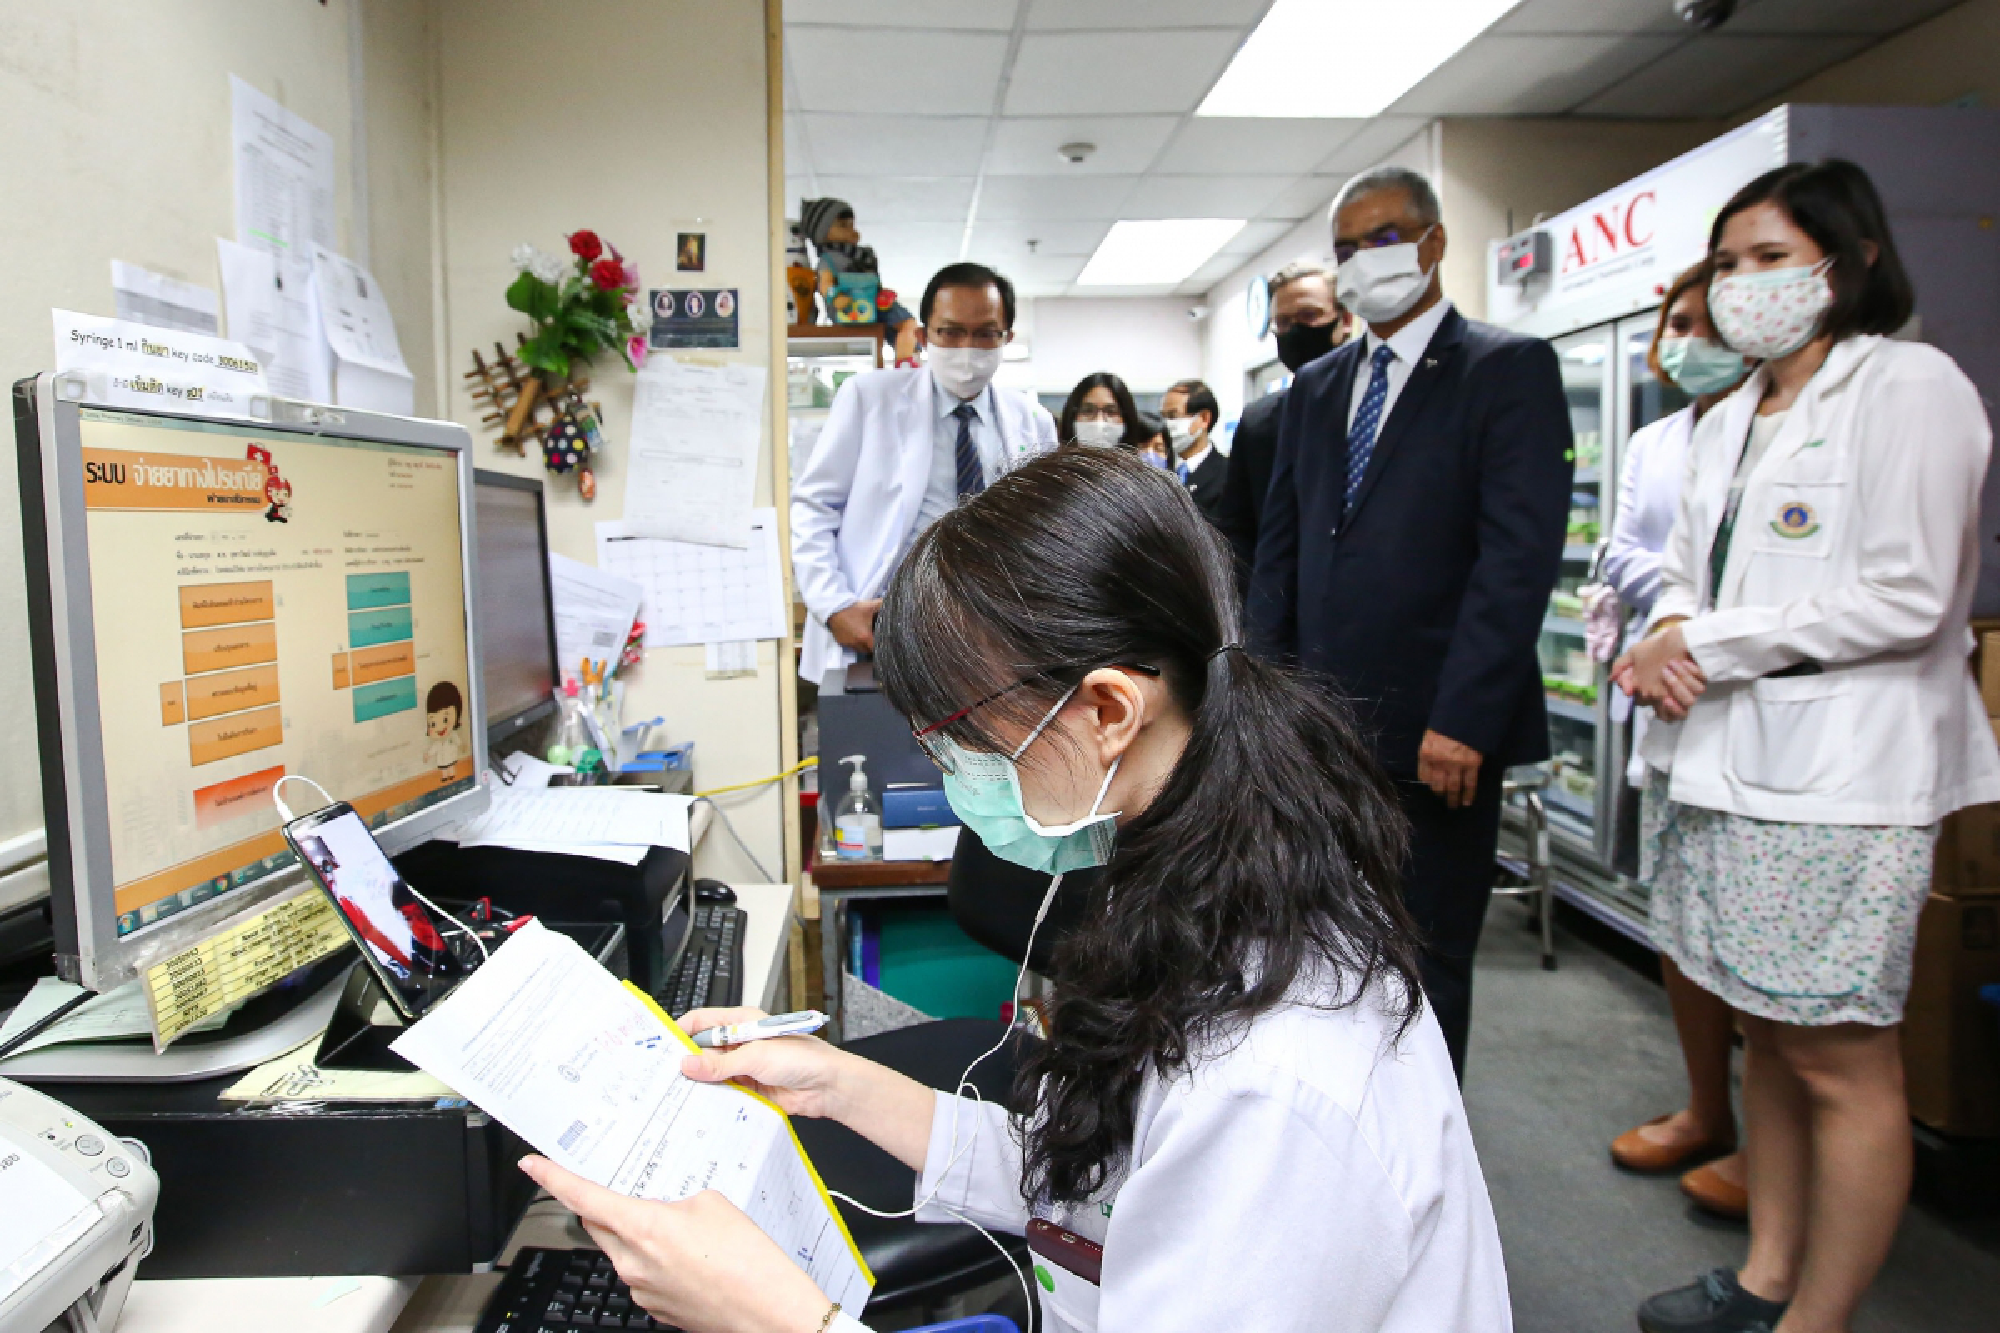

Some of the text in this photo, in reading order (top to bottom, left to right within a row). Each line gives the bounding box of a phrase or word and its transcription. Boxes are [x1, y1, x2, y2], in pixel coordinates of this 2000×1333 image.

[1562, 190, 1656, 273] ANC
[70, 329, 115, 350] Syringe
[172, 347, 188, 363] key
[86, 462, 126, 485] ระบบ
